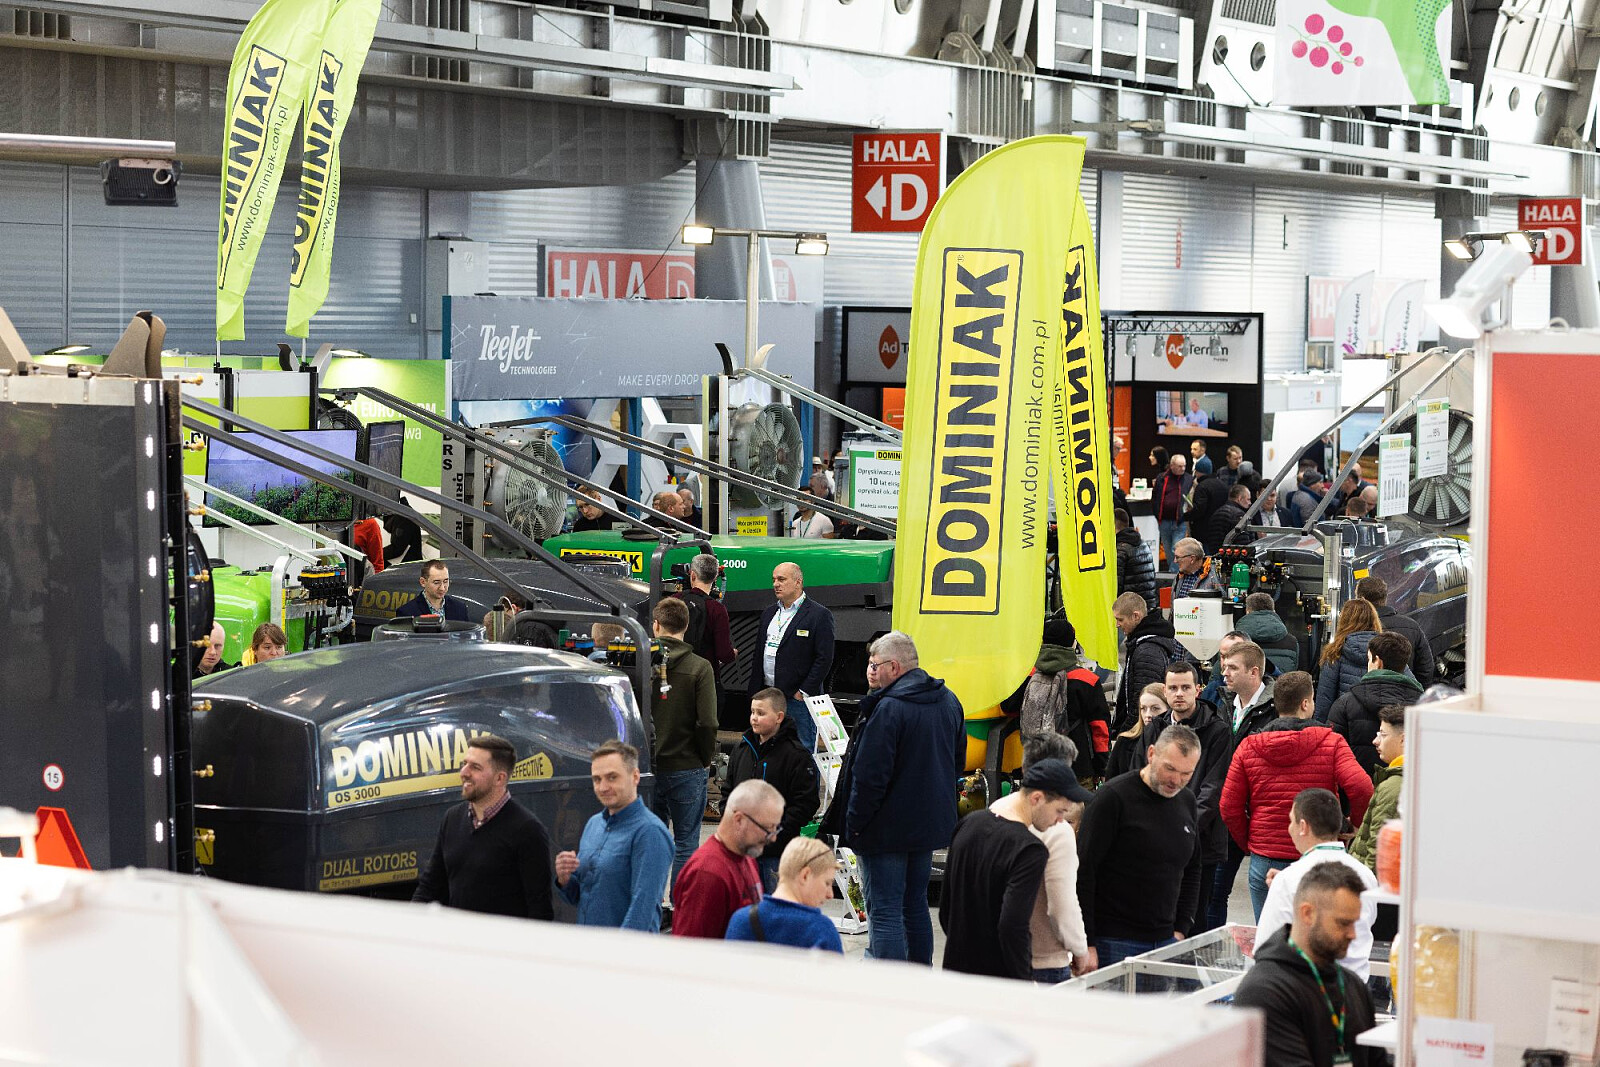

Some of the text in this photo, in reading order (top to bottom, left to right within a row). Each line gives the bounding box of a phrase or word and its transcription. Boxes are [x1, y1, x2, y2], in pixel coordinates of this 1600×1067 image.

[863, 140, 931, 162] HALA
[237, 105, 288, 251] www.dominiak.com.pl
[890, 173, 928, 221] D
[1524, 205, 1576, 221] HALA
[1547, 227, 1575, 260] D
[478, 324, 541, 373] TeeJet
[881, 341, 898, 354] Ad
[511, 366, 557, 375] TECHNOLOGIES
[618, 374, 643, 386] MAKE
[645, 374, 673, 386] EVERY
[674, 373, 700, 385] DROP
[931, 263, 1009, 597] DOMINIAK
[1021, 319, 1050, 549] www.dominiak.com.pl
[869, 477, 878, 486] 10
[723, 559, 747, 568] 2000
[47, 772, 59, 783] 15
[335, 786, 381, 803] OS 3000
[323, 851, 417, 877] DUAL ROTORS
